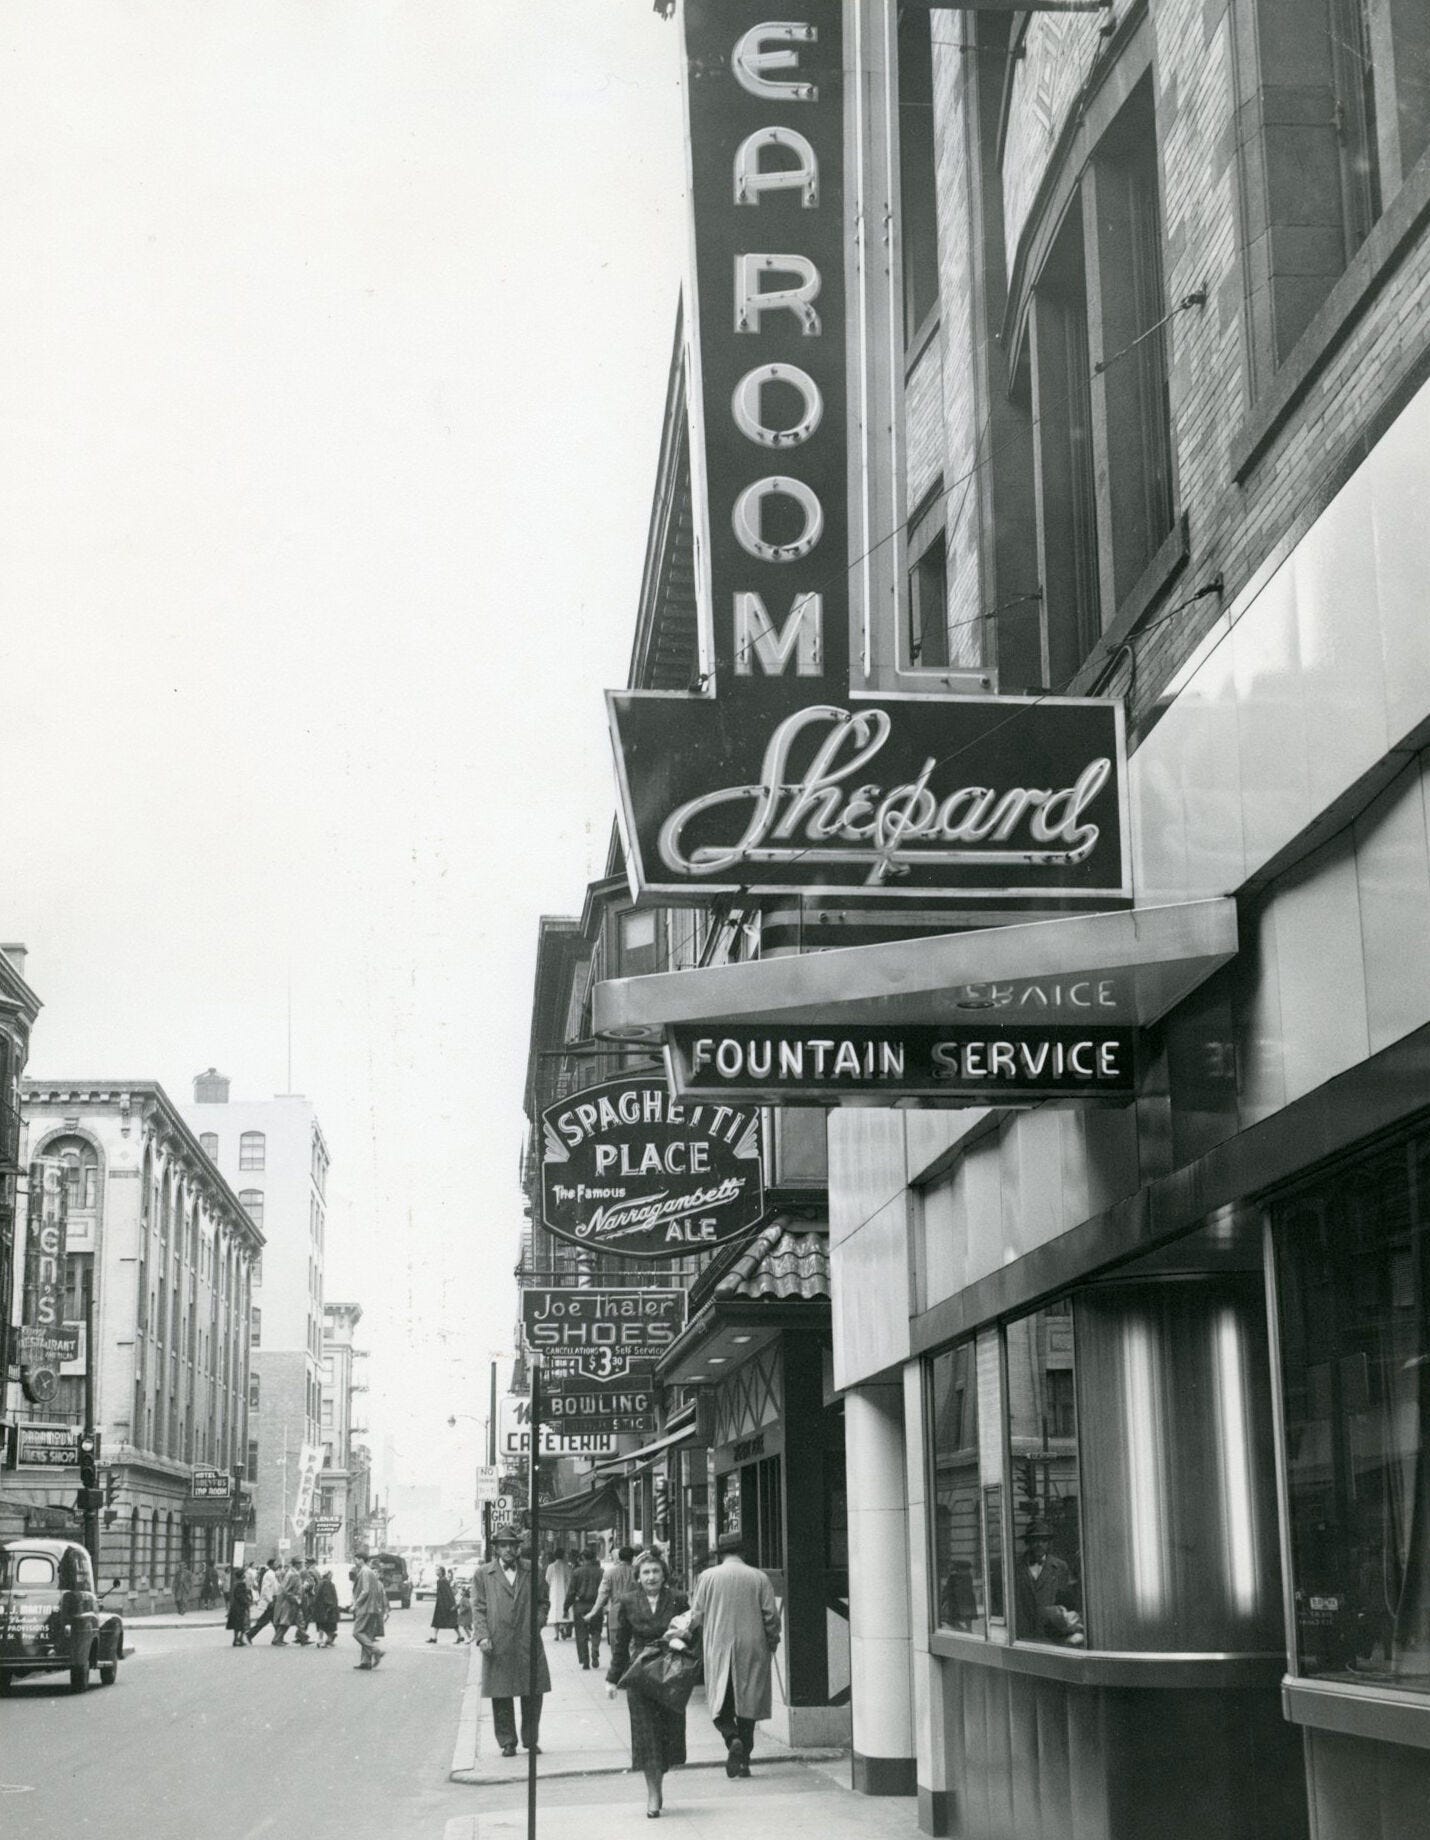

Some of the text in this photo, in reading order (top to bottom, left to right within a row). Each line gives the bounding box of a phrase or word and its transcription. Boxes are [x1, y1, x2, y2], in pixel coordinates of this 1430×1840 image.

[658, 704, 1111, 886] Shepard
[693, 1038, 1120, 1079] FOUNTAIN SERVICE
[595, 1141, 711, 1176] PLACE
[552, 1184, 626, 1204] The Famous
[575, 1177, 746, 1240] Narragansett
[665, 1218, 718, 1242] ALE
[534, 1290, 677, 1319] Joe Thaler
[533, 1322, 675, 1344] SHOES
[551, 1393, 649, 1416] BOWLING
[7, 1624, 50, 1632] PROVISIONS
